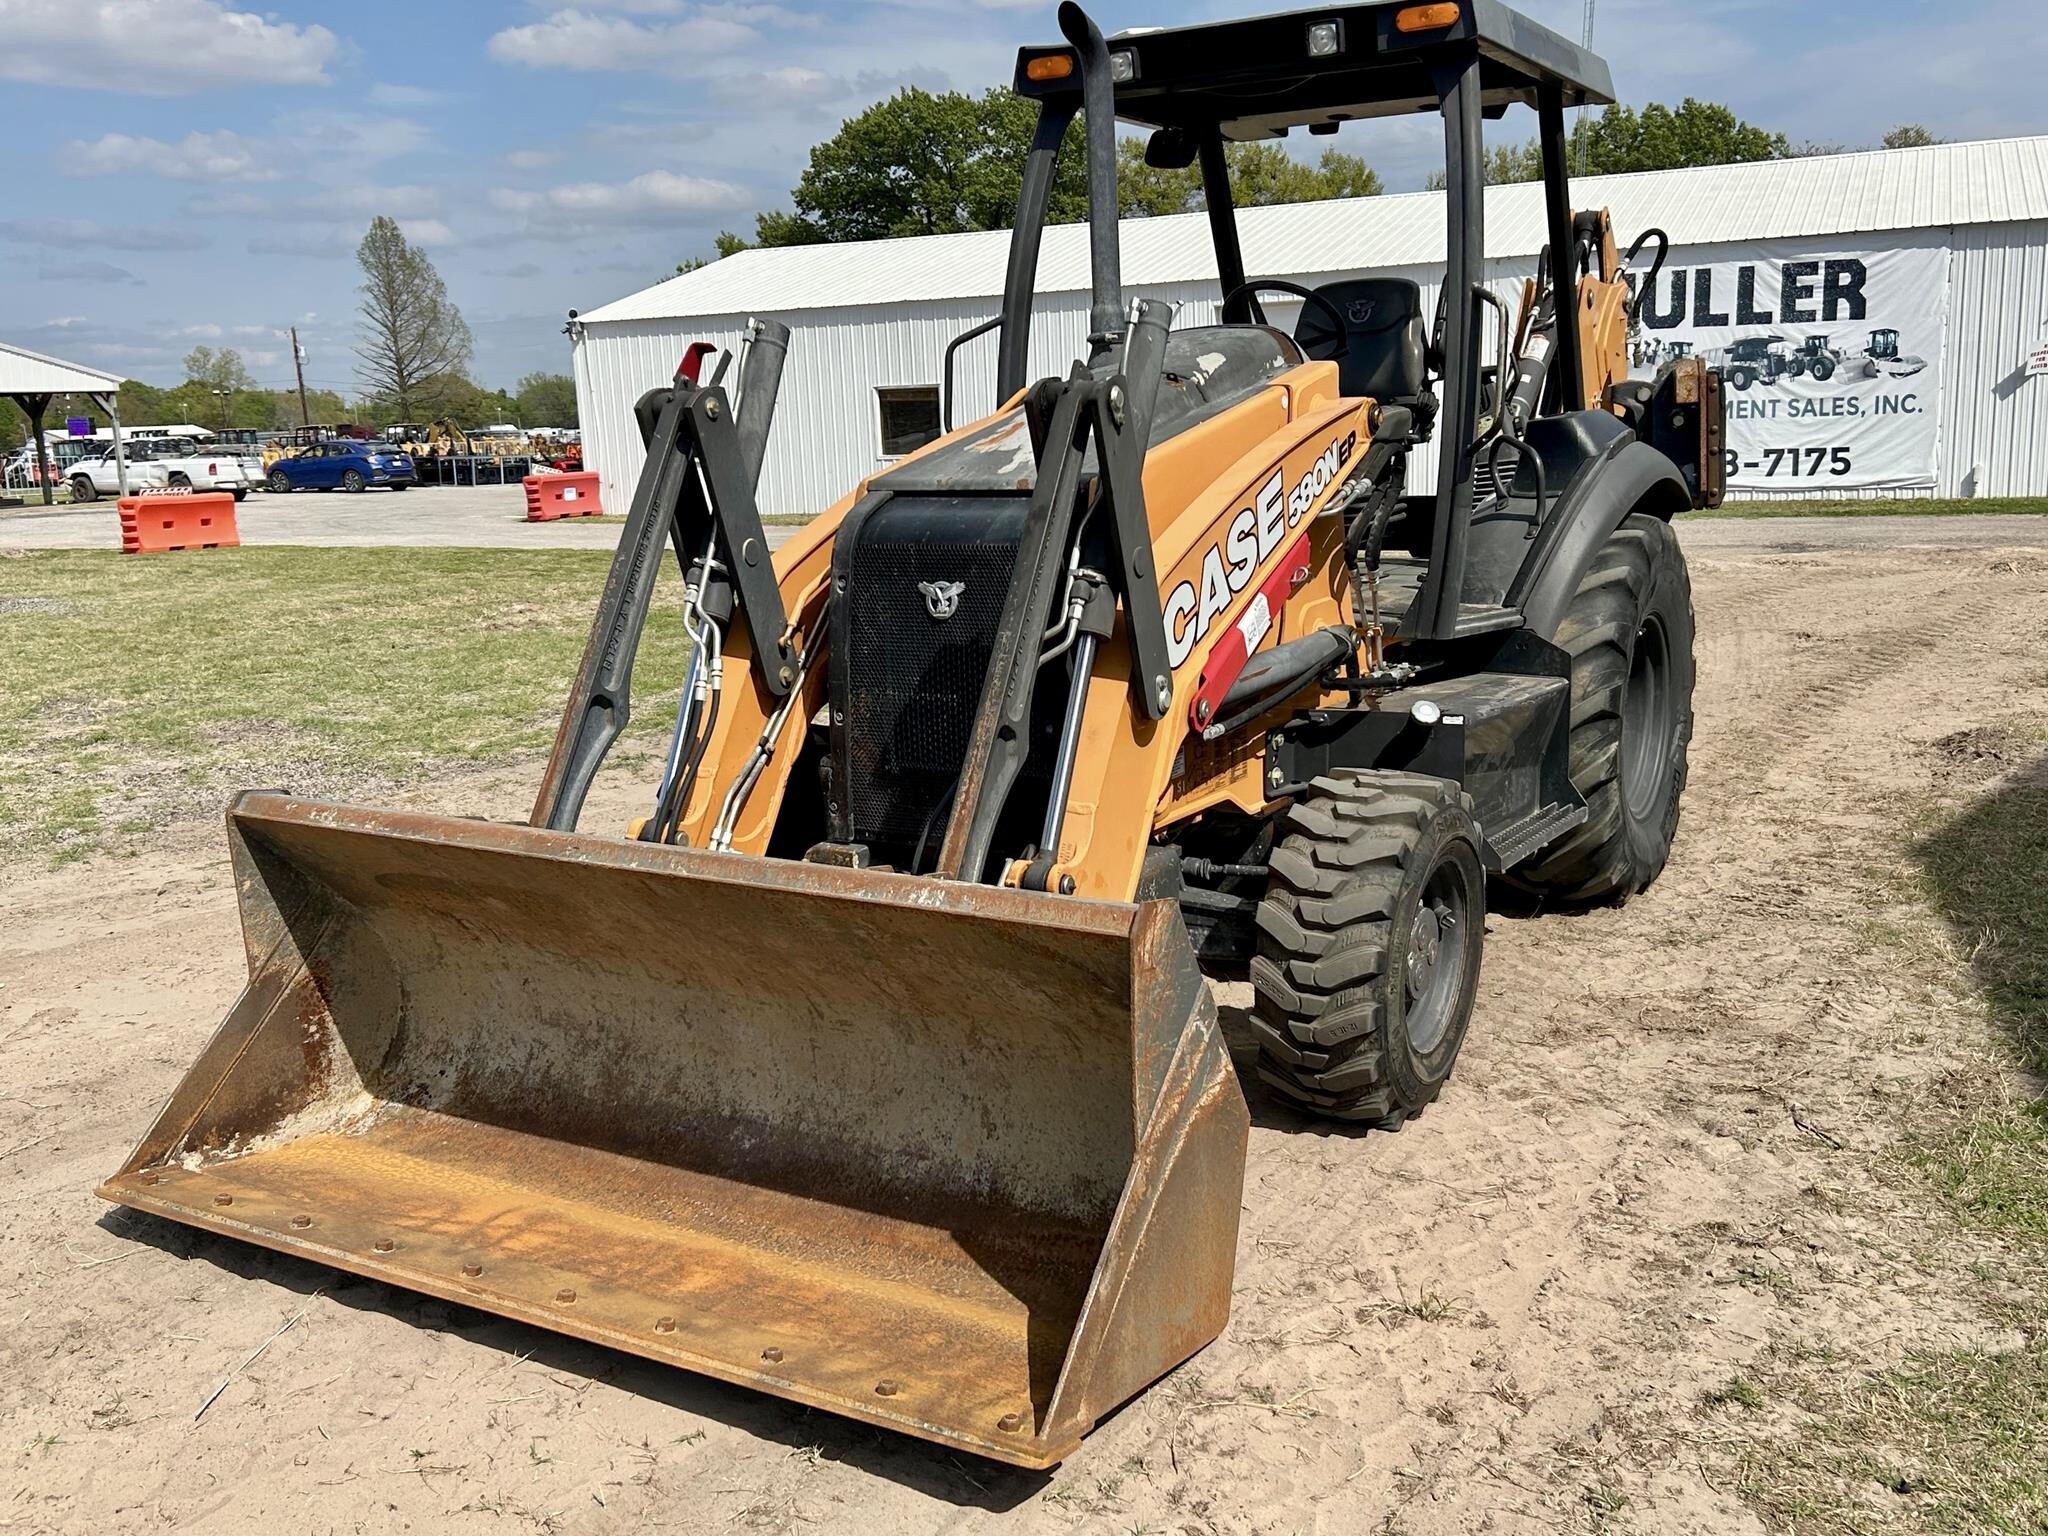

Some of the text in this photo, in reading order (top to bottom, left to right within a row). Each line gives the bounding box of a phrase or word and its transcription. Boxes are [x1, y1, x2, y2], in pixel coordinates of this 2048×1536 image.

[1787, 396, 1866, 418] SALES,
[1874, 394, 1923, 415] INC.
[1162, 465, 1286, 670] CASE
[1287, 436, 1340, 528] 580N
[1339, 430, 1357, 470] EP
